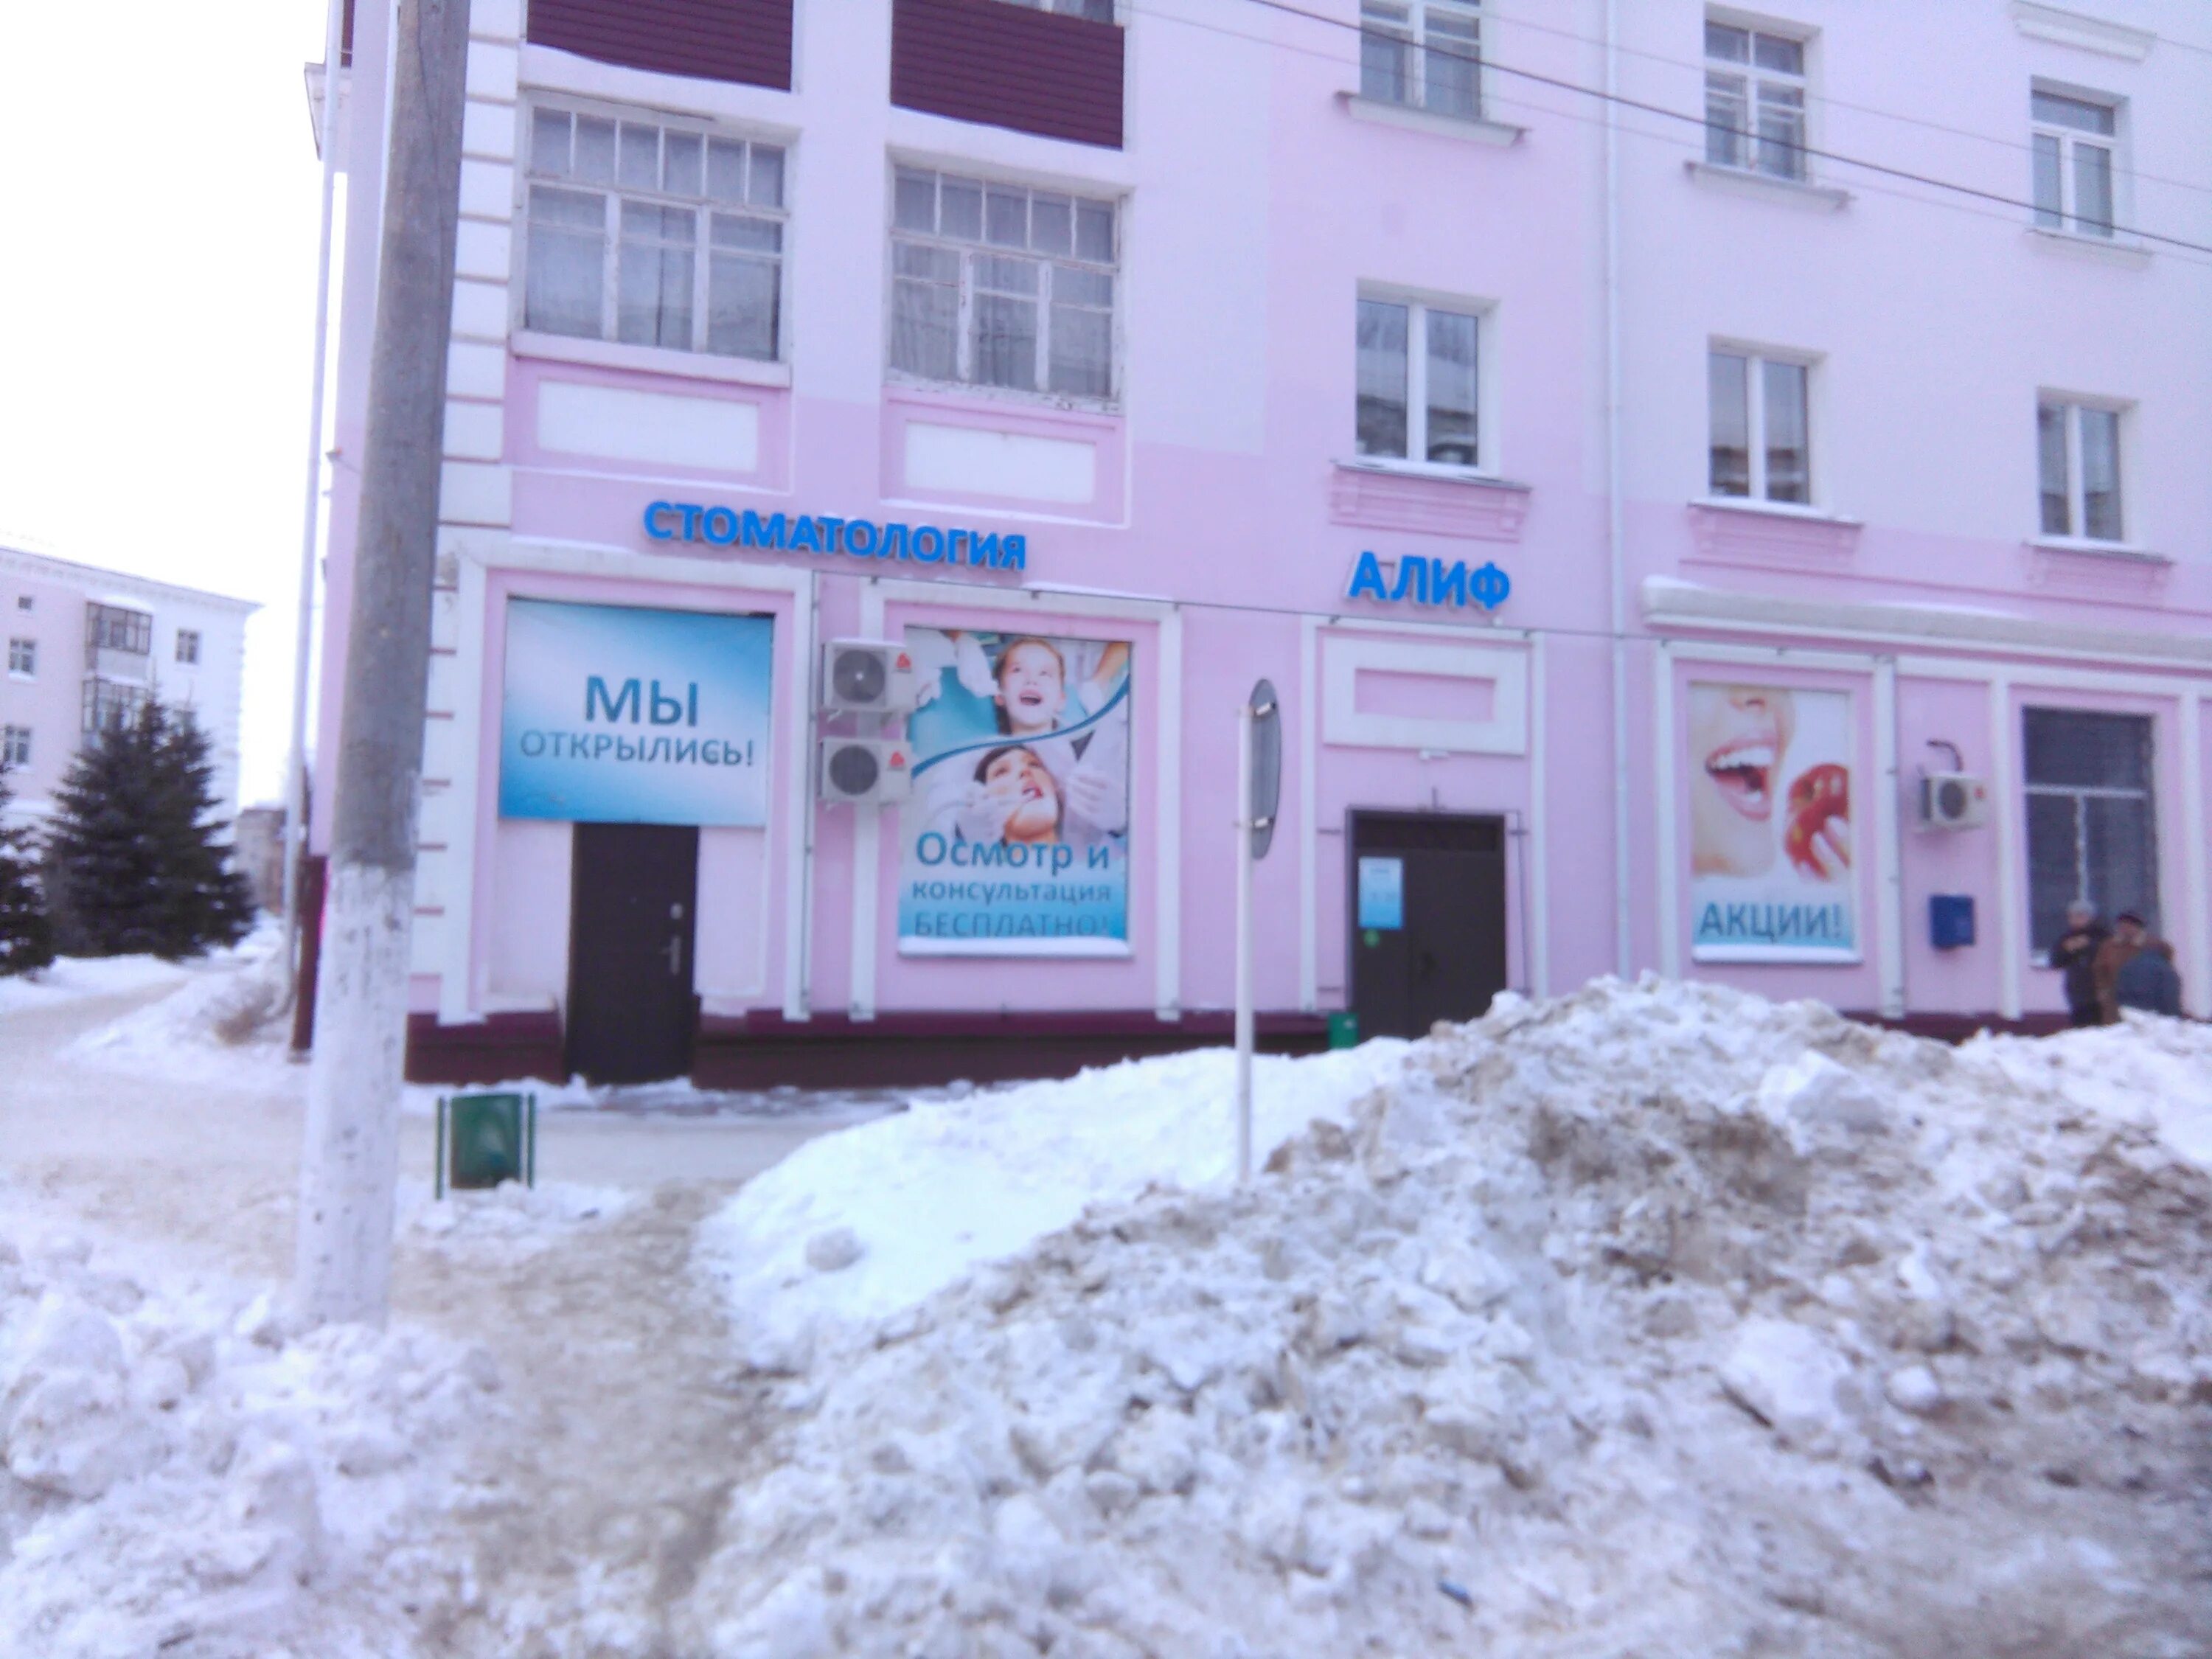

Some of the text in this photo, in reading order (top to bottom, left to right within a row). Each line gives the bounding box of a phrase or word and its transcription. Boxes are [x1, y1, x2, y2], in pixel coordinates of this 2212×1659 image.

[644, 501, 1026, 571] СТОМАТОЛОГИЯ
[1349, 551, 1510, 611] АЛИФ
[585, 675, 698, 727] МЫ
[521, 729, 754, 767] ОТКРЫЛИСЬ!
[917, 831, 1110, 876] Осмотр и
[912, 881, 1111, 906] консультация
[1699, 901, 1842, 943] АКЦИИ!
